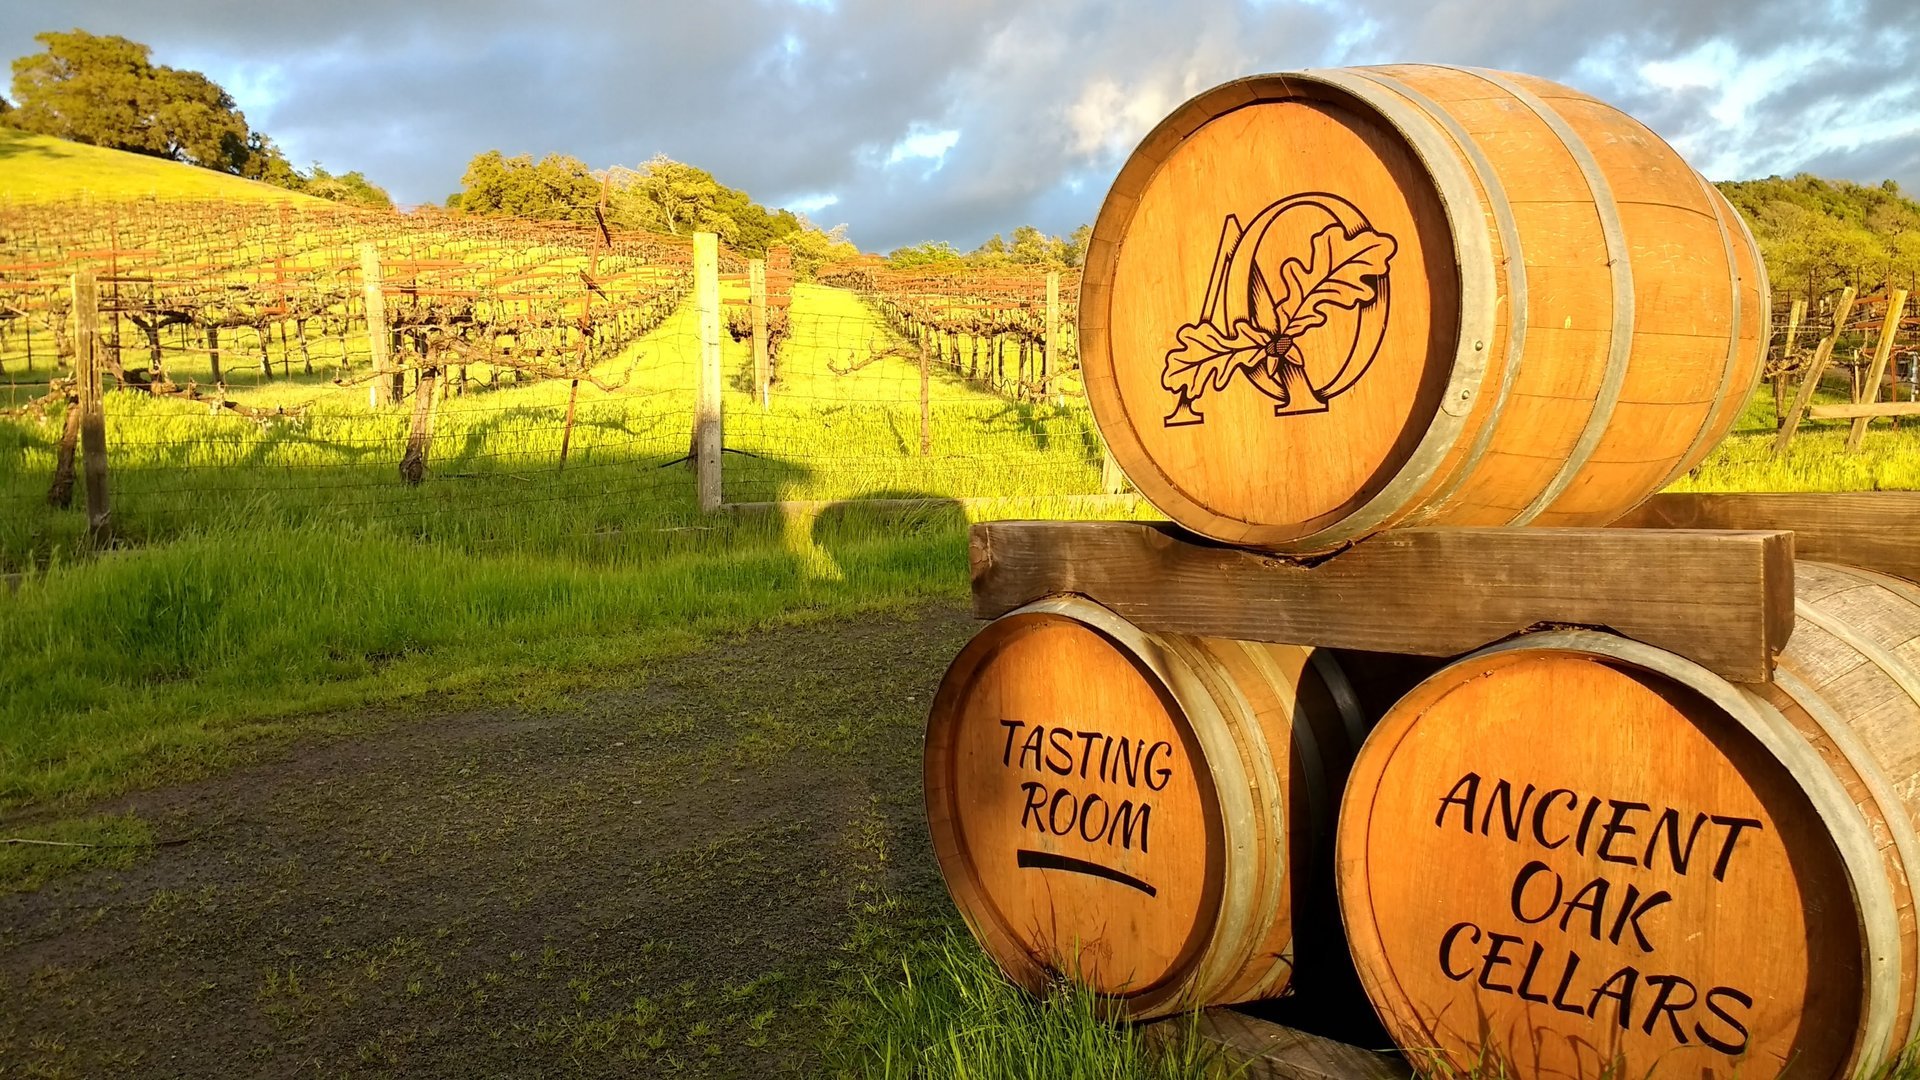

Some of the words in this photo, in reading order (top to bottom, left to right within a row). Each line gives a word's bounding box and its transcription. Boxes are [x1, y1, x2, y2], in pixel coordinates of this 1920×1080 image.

[1000, 719, 1173, 791] TASTING
[1021, 781, 1152, 853] ROOM
[1435, 772, 1763, 882] ANCIENT
[1511, 860, 1673, 953] OAK
[1438, 922, 1754, 1055] CELLARS
